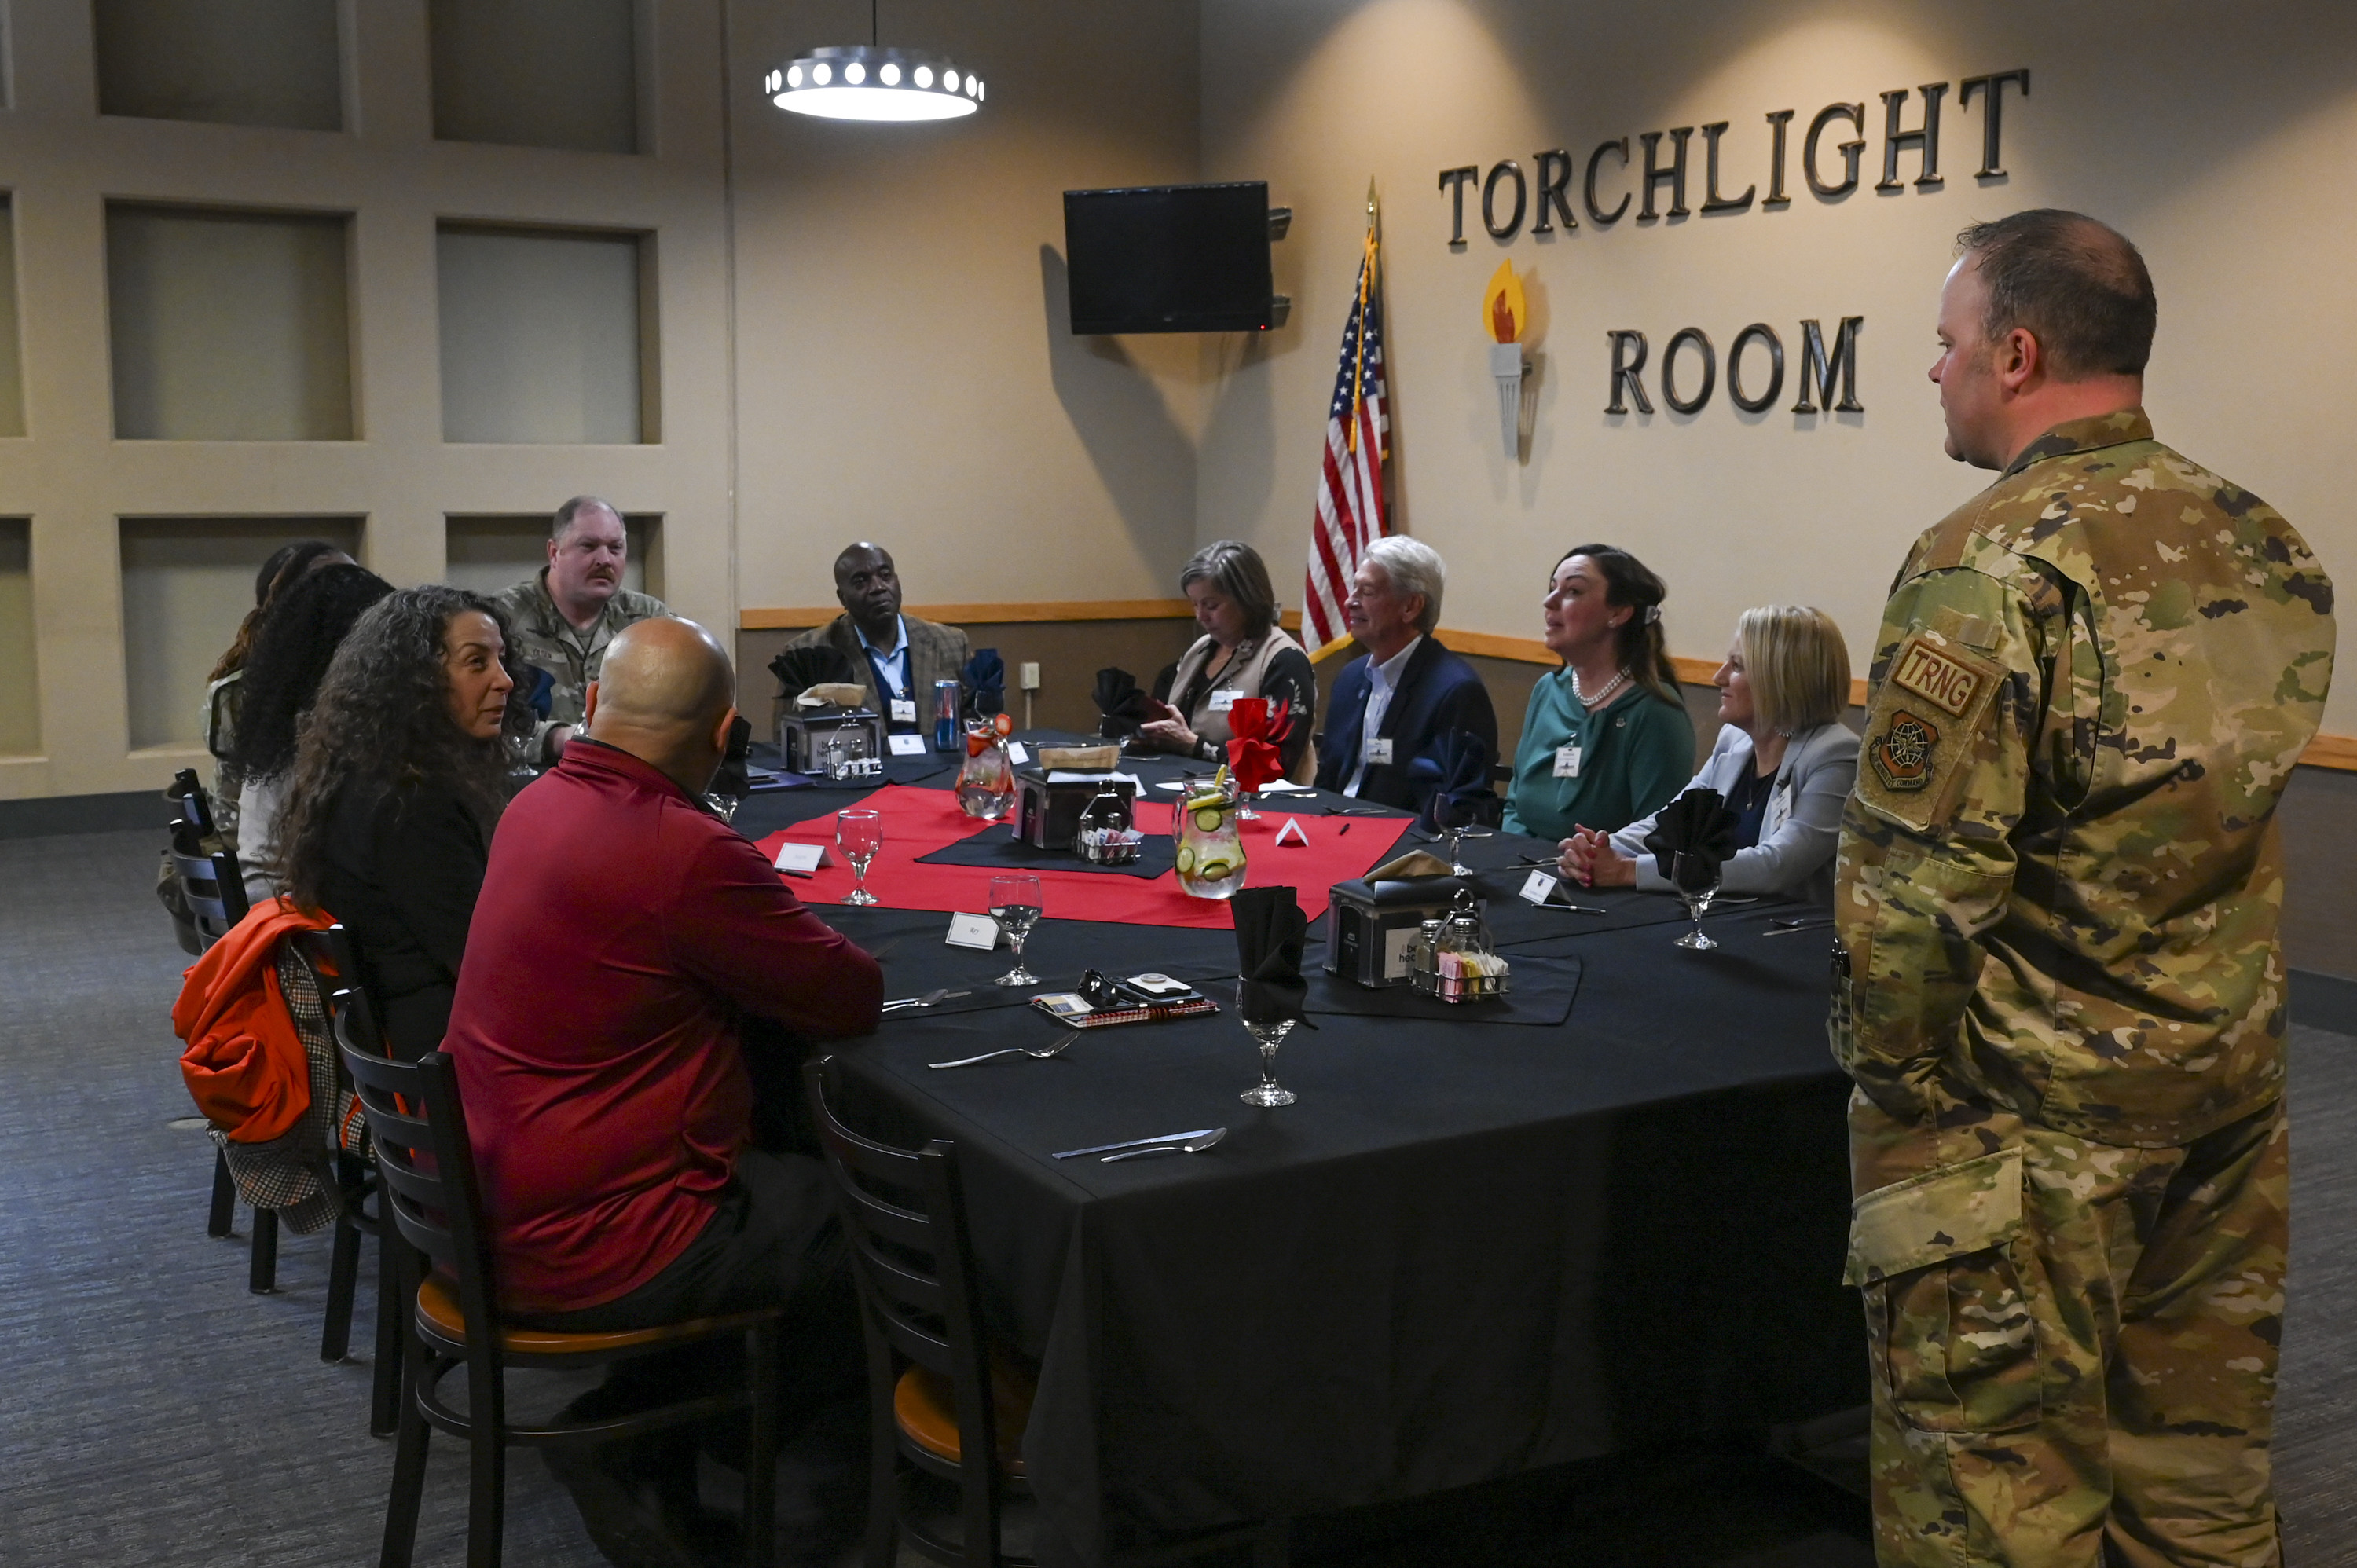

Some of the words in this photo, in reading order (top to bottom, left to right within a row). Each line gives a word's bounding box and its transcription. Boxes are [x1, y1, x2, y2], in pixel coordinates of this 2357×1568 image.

[1439, 68, 2030, 246] TORCHLIGHT
[1604, 316, 1864, 415] ROOM
[1905, 649, 1972, 706] TRNG
